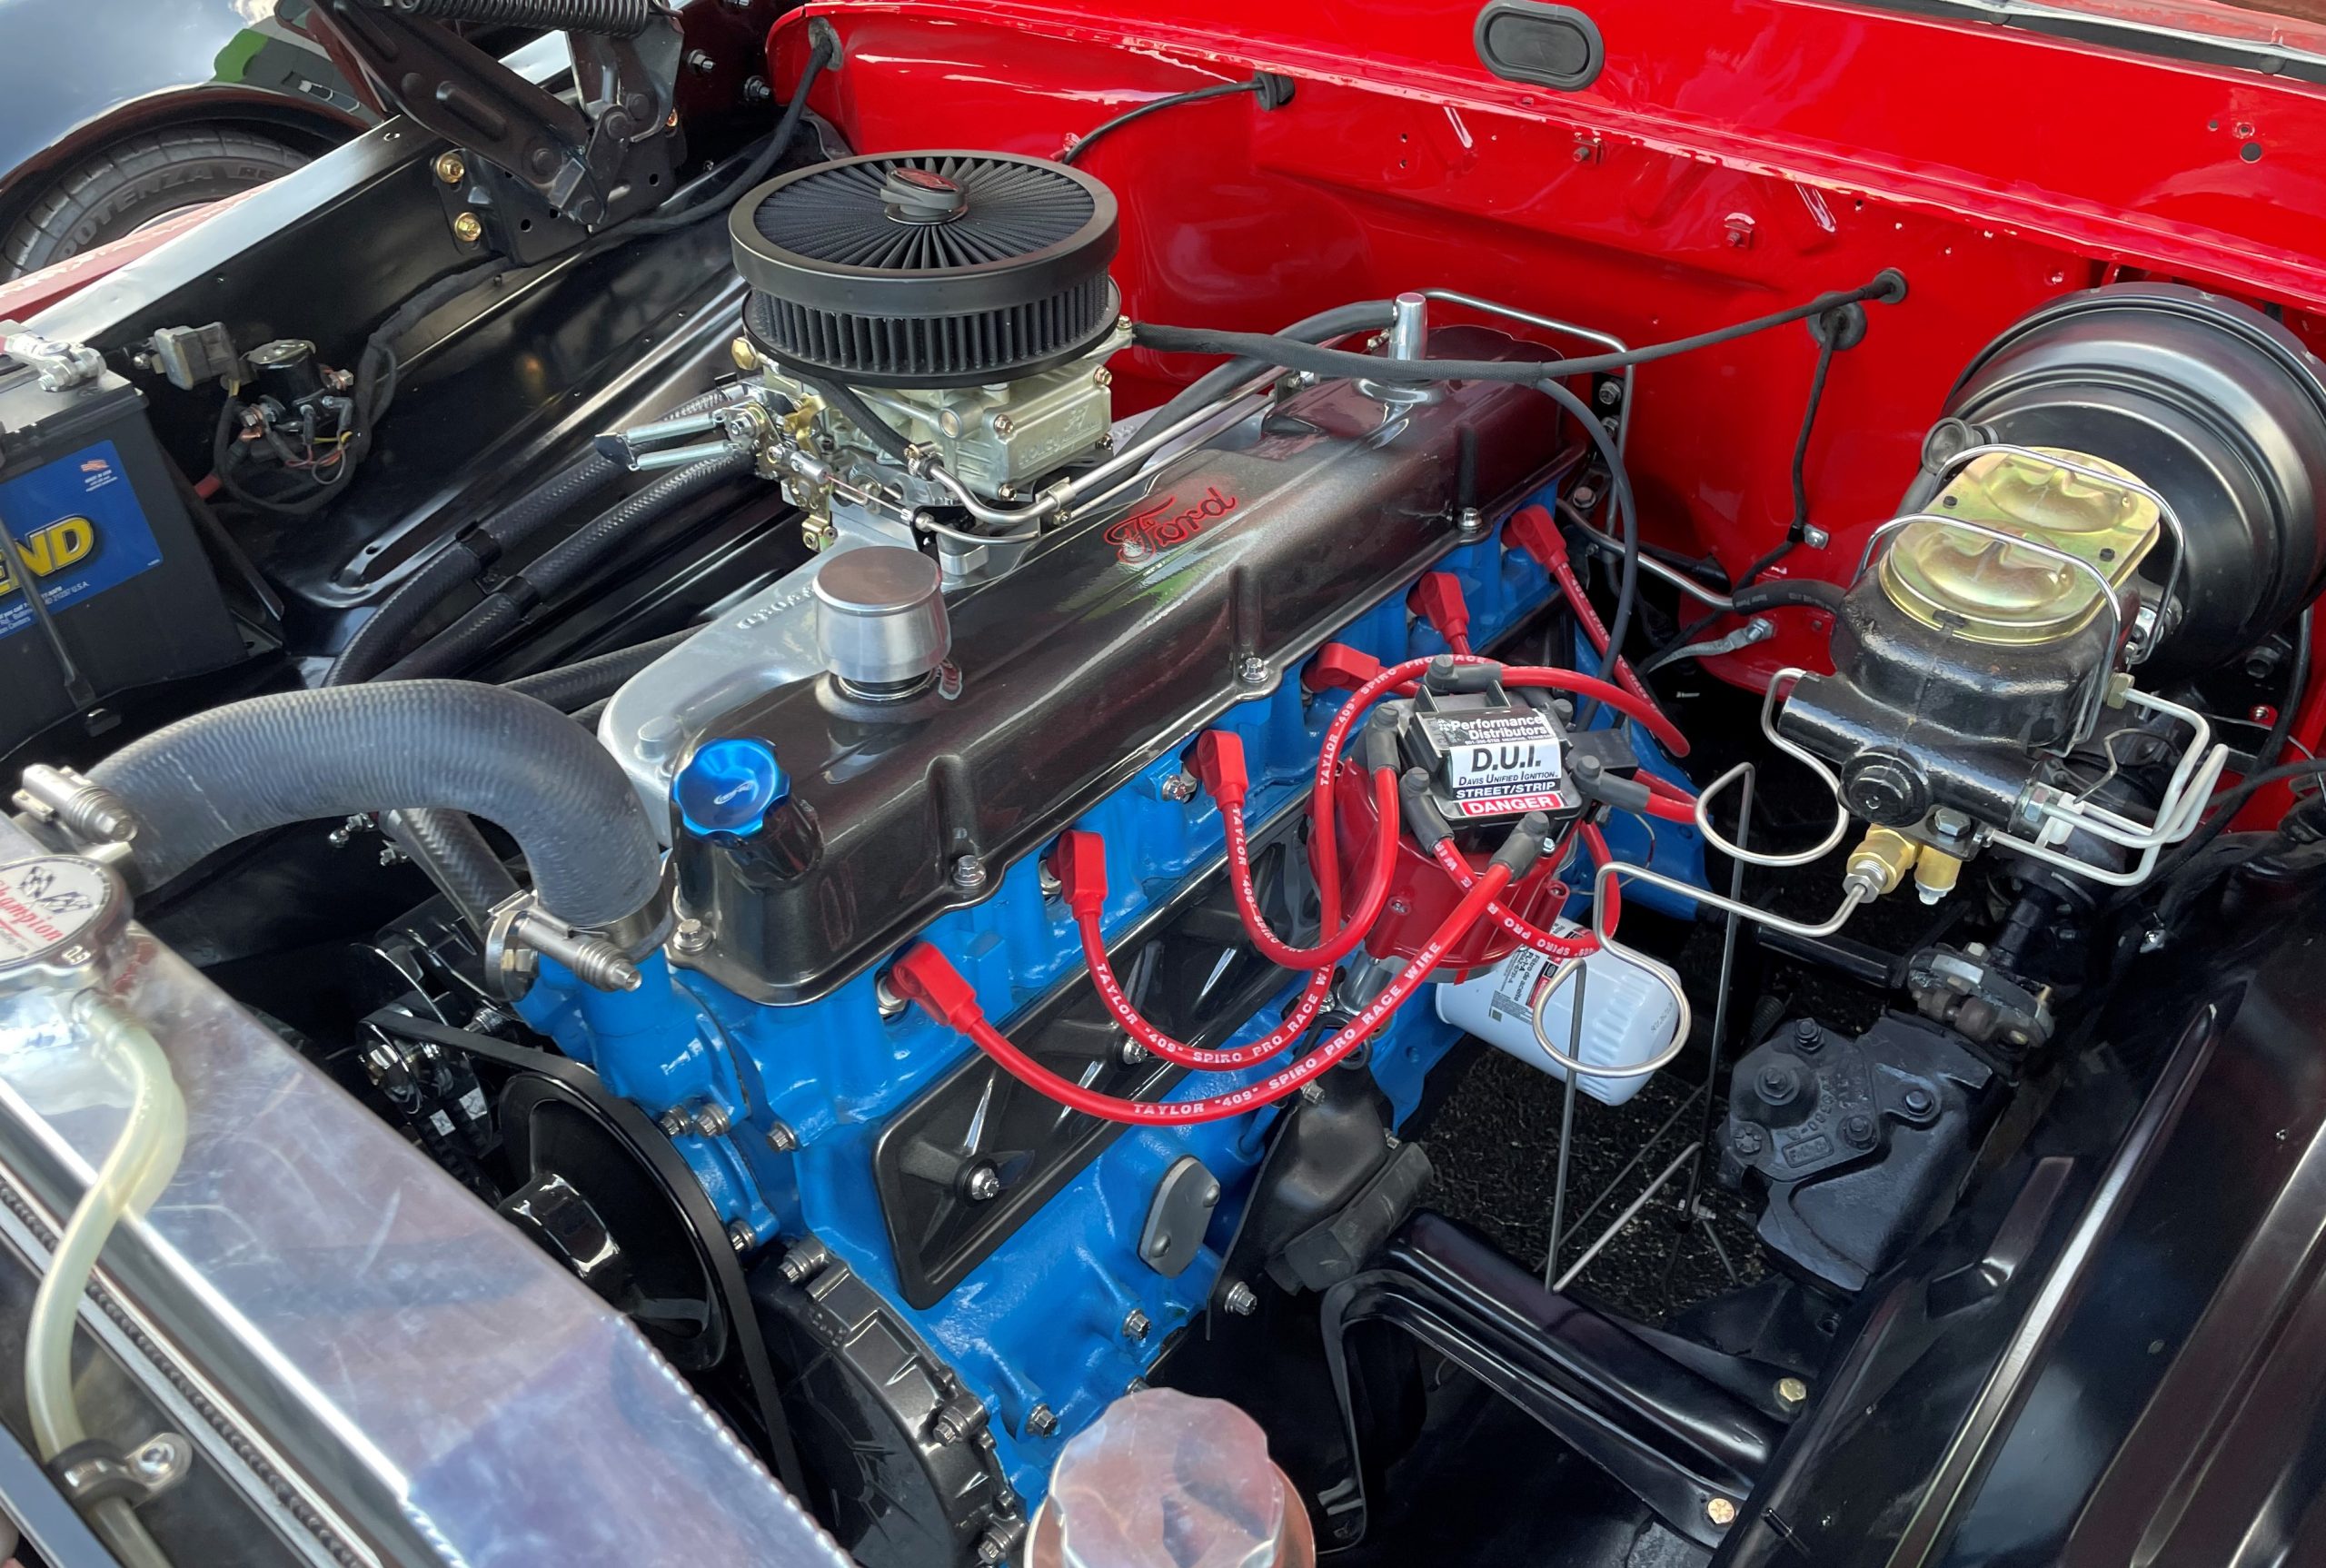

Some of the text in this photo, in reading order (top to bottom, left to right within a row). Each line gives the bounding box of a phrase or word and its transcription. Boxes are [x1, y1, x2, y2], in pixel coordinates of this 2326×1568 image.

[1104, 486, 1238, 564] Ford
[1320, 654, 1486, 786] TAYLOR "409" SPIRO PRO ACE
[1452, 715, 1544, 731] Performance
[1468, 726, 1550, 740] Distributors
[1471, 745, 1542, 773] D.U.I.
[1456, 782, 1556, 799] STREET/STRIP
[1458, 777, 1484, 787] DAVIS
[1486, 773, 1519, 783] UNIFIED
[1468, 797, 1555, 814] DANGER
[1434, 840, 1459, 873] WIR
[1232, 809, 1247, 866] TAYLOR
[1254, 915, 1279, 944] SPIRO
[1504, 917, 1533, 940] PRO
[1536, 936, 1570, 957] SPIRO
[1097, 963, 1138, 1025] TAYLOR
[1145, 1027, 1183, 1053] "409"
[1192, 1051, 1243, 1064] SPIRO
[1252, 1035, 1284, 1057] PRO
[1287, 993, 1318, 1033] RACE
[1134, 941, 1442, 1116] TAYLOR "409" SPIRO PRO RACE WIRE
